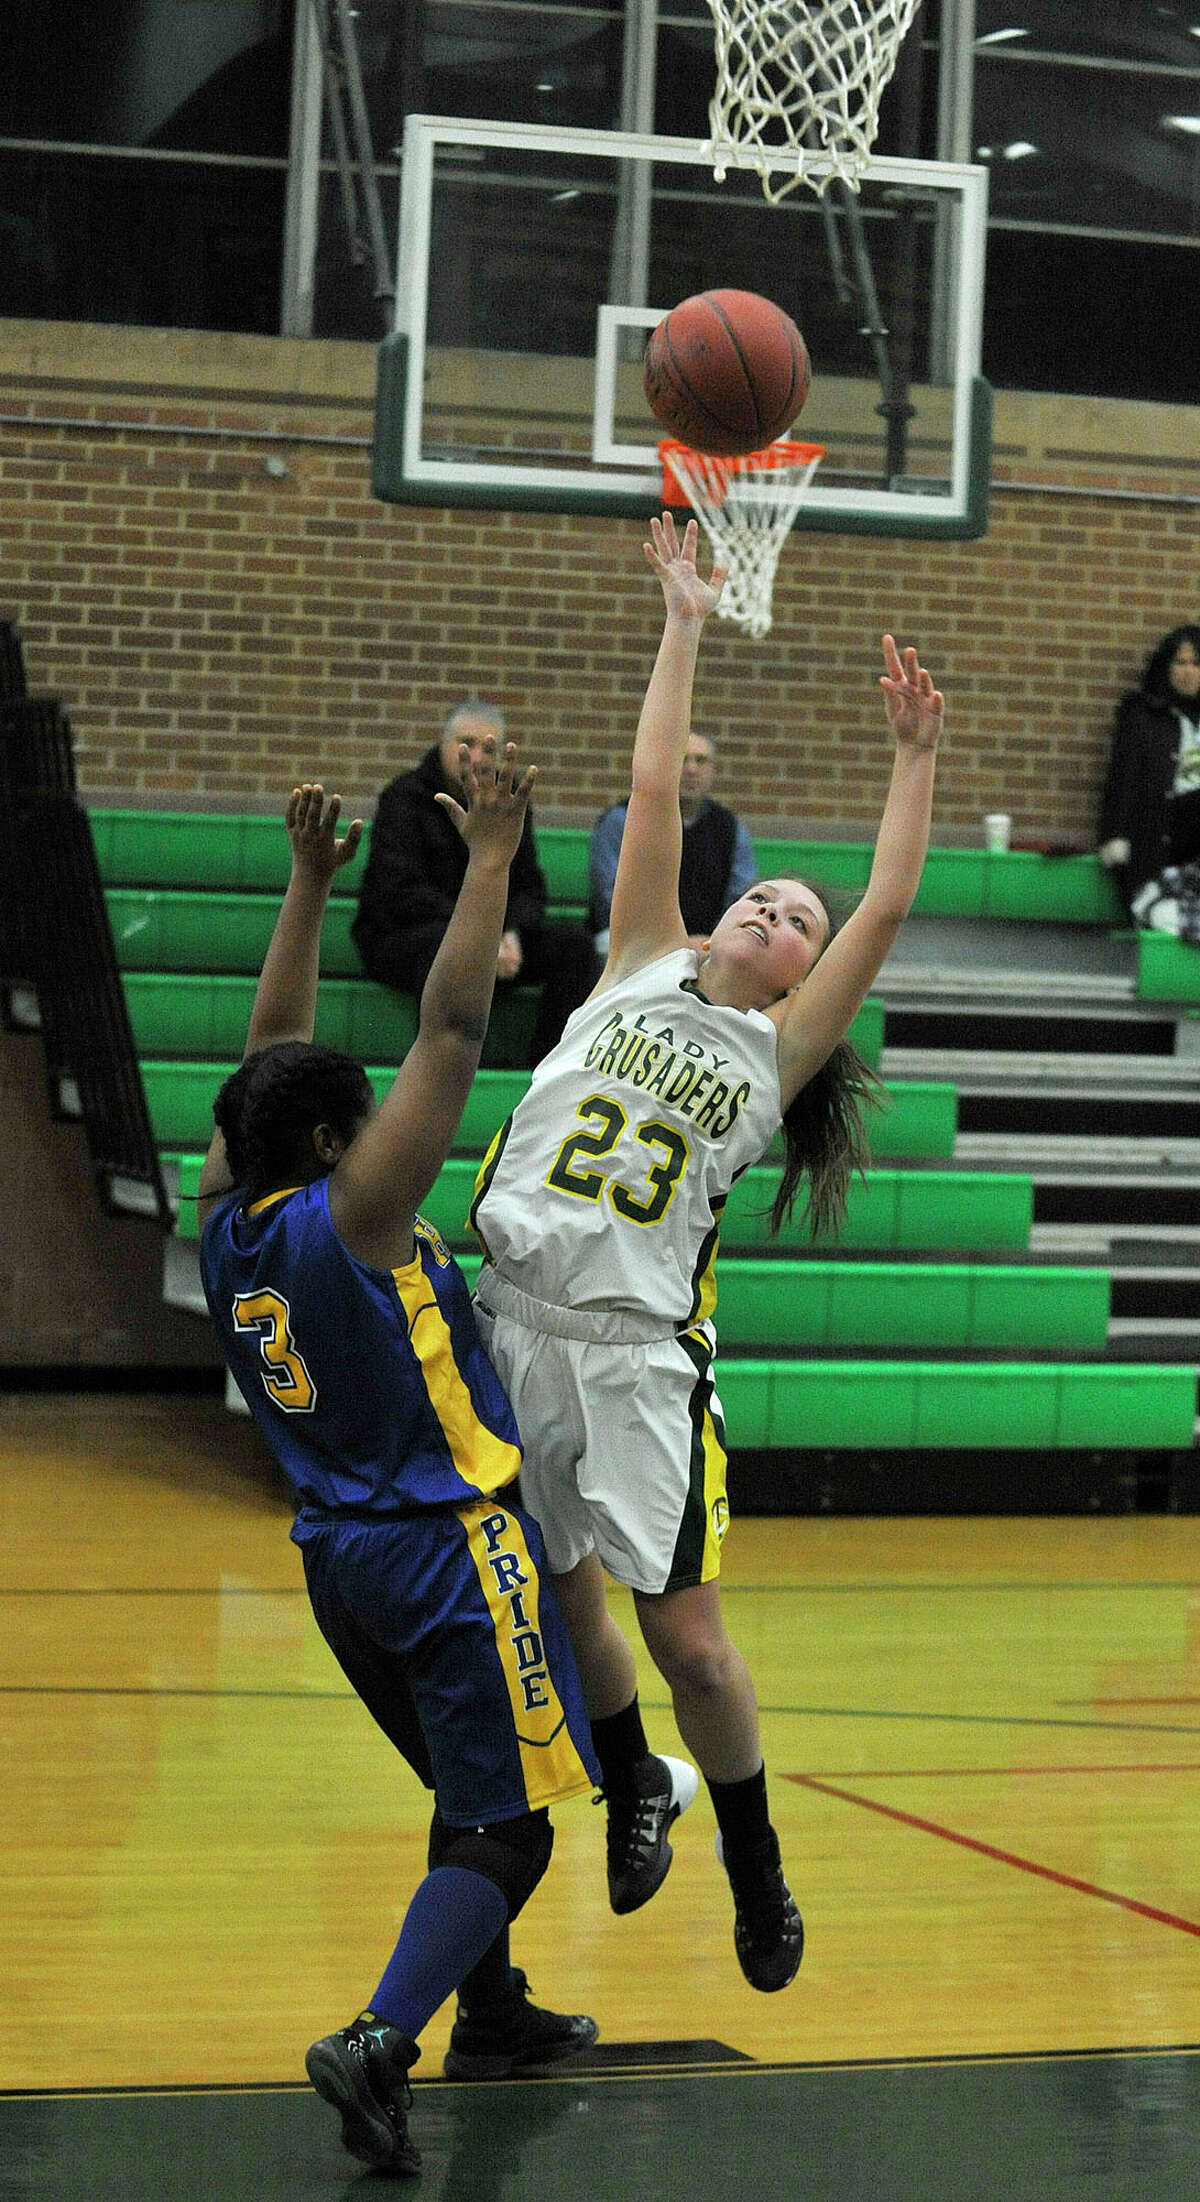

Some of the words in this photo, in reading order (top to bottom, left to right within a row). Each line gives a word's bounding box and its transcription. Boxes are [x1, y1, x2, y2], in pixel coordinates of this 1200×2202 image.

[584, 1011, 751, 1139] CRUSADERS
[634, 1014, 730, 1071] LADY
[545, 1093, 691, 1227] 23
[232, 1286, 317, 1413] 3
[480, 1511, 549, 1712] PRIDE
